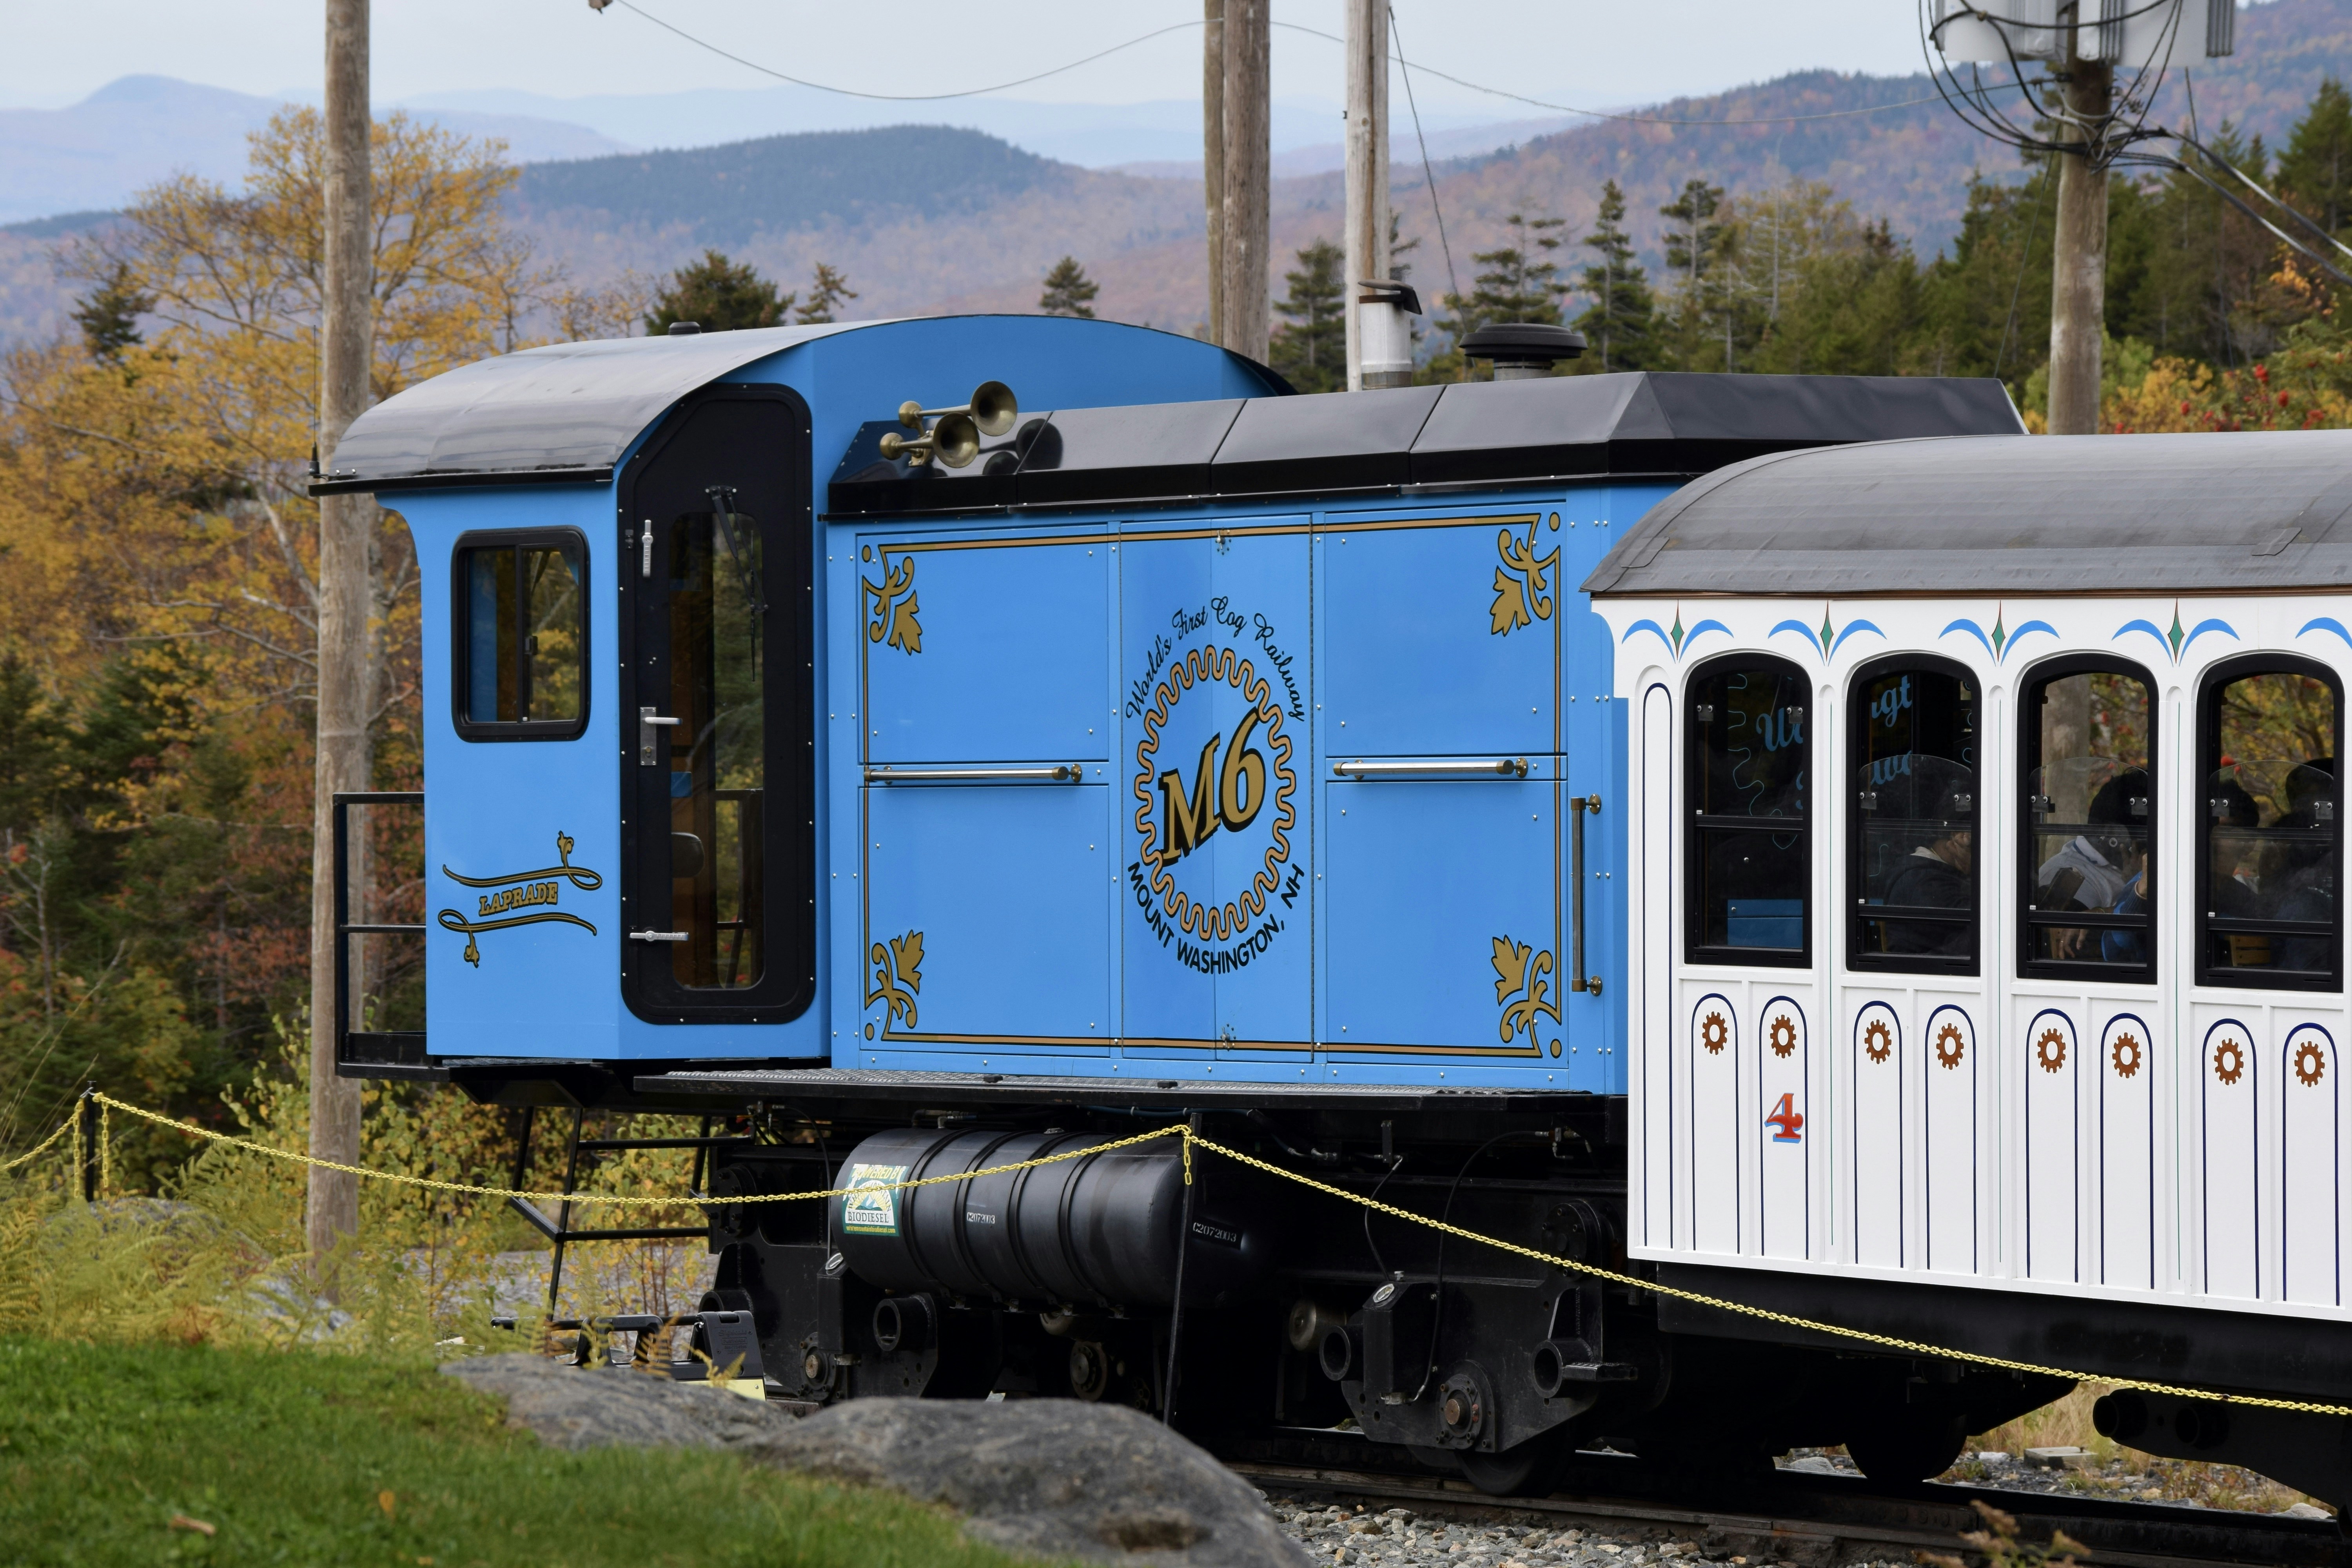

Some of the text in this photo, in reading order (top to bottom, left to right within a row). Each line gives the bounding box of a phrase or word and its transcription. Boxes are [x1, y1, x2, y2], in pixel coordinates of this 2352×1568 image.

[1126, 596, 1305, 722] World's First Cog Railway
[1158, 706, 1266, 867] M6
[479, 882, 558, 917] LAPRADE
[1128, 862, 1305, 975] MOUNT WASHINGTON, NH
[1764, 1093, 1804, 1144] 4
[851, 1167, 893, 1179] POWERED
[848, 1212, 889, 1223] BIODIESEL
[967, 1212, 995, 1224] C2072003
[1192, 1222, 1237, 1242] C2072003
